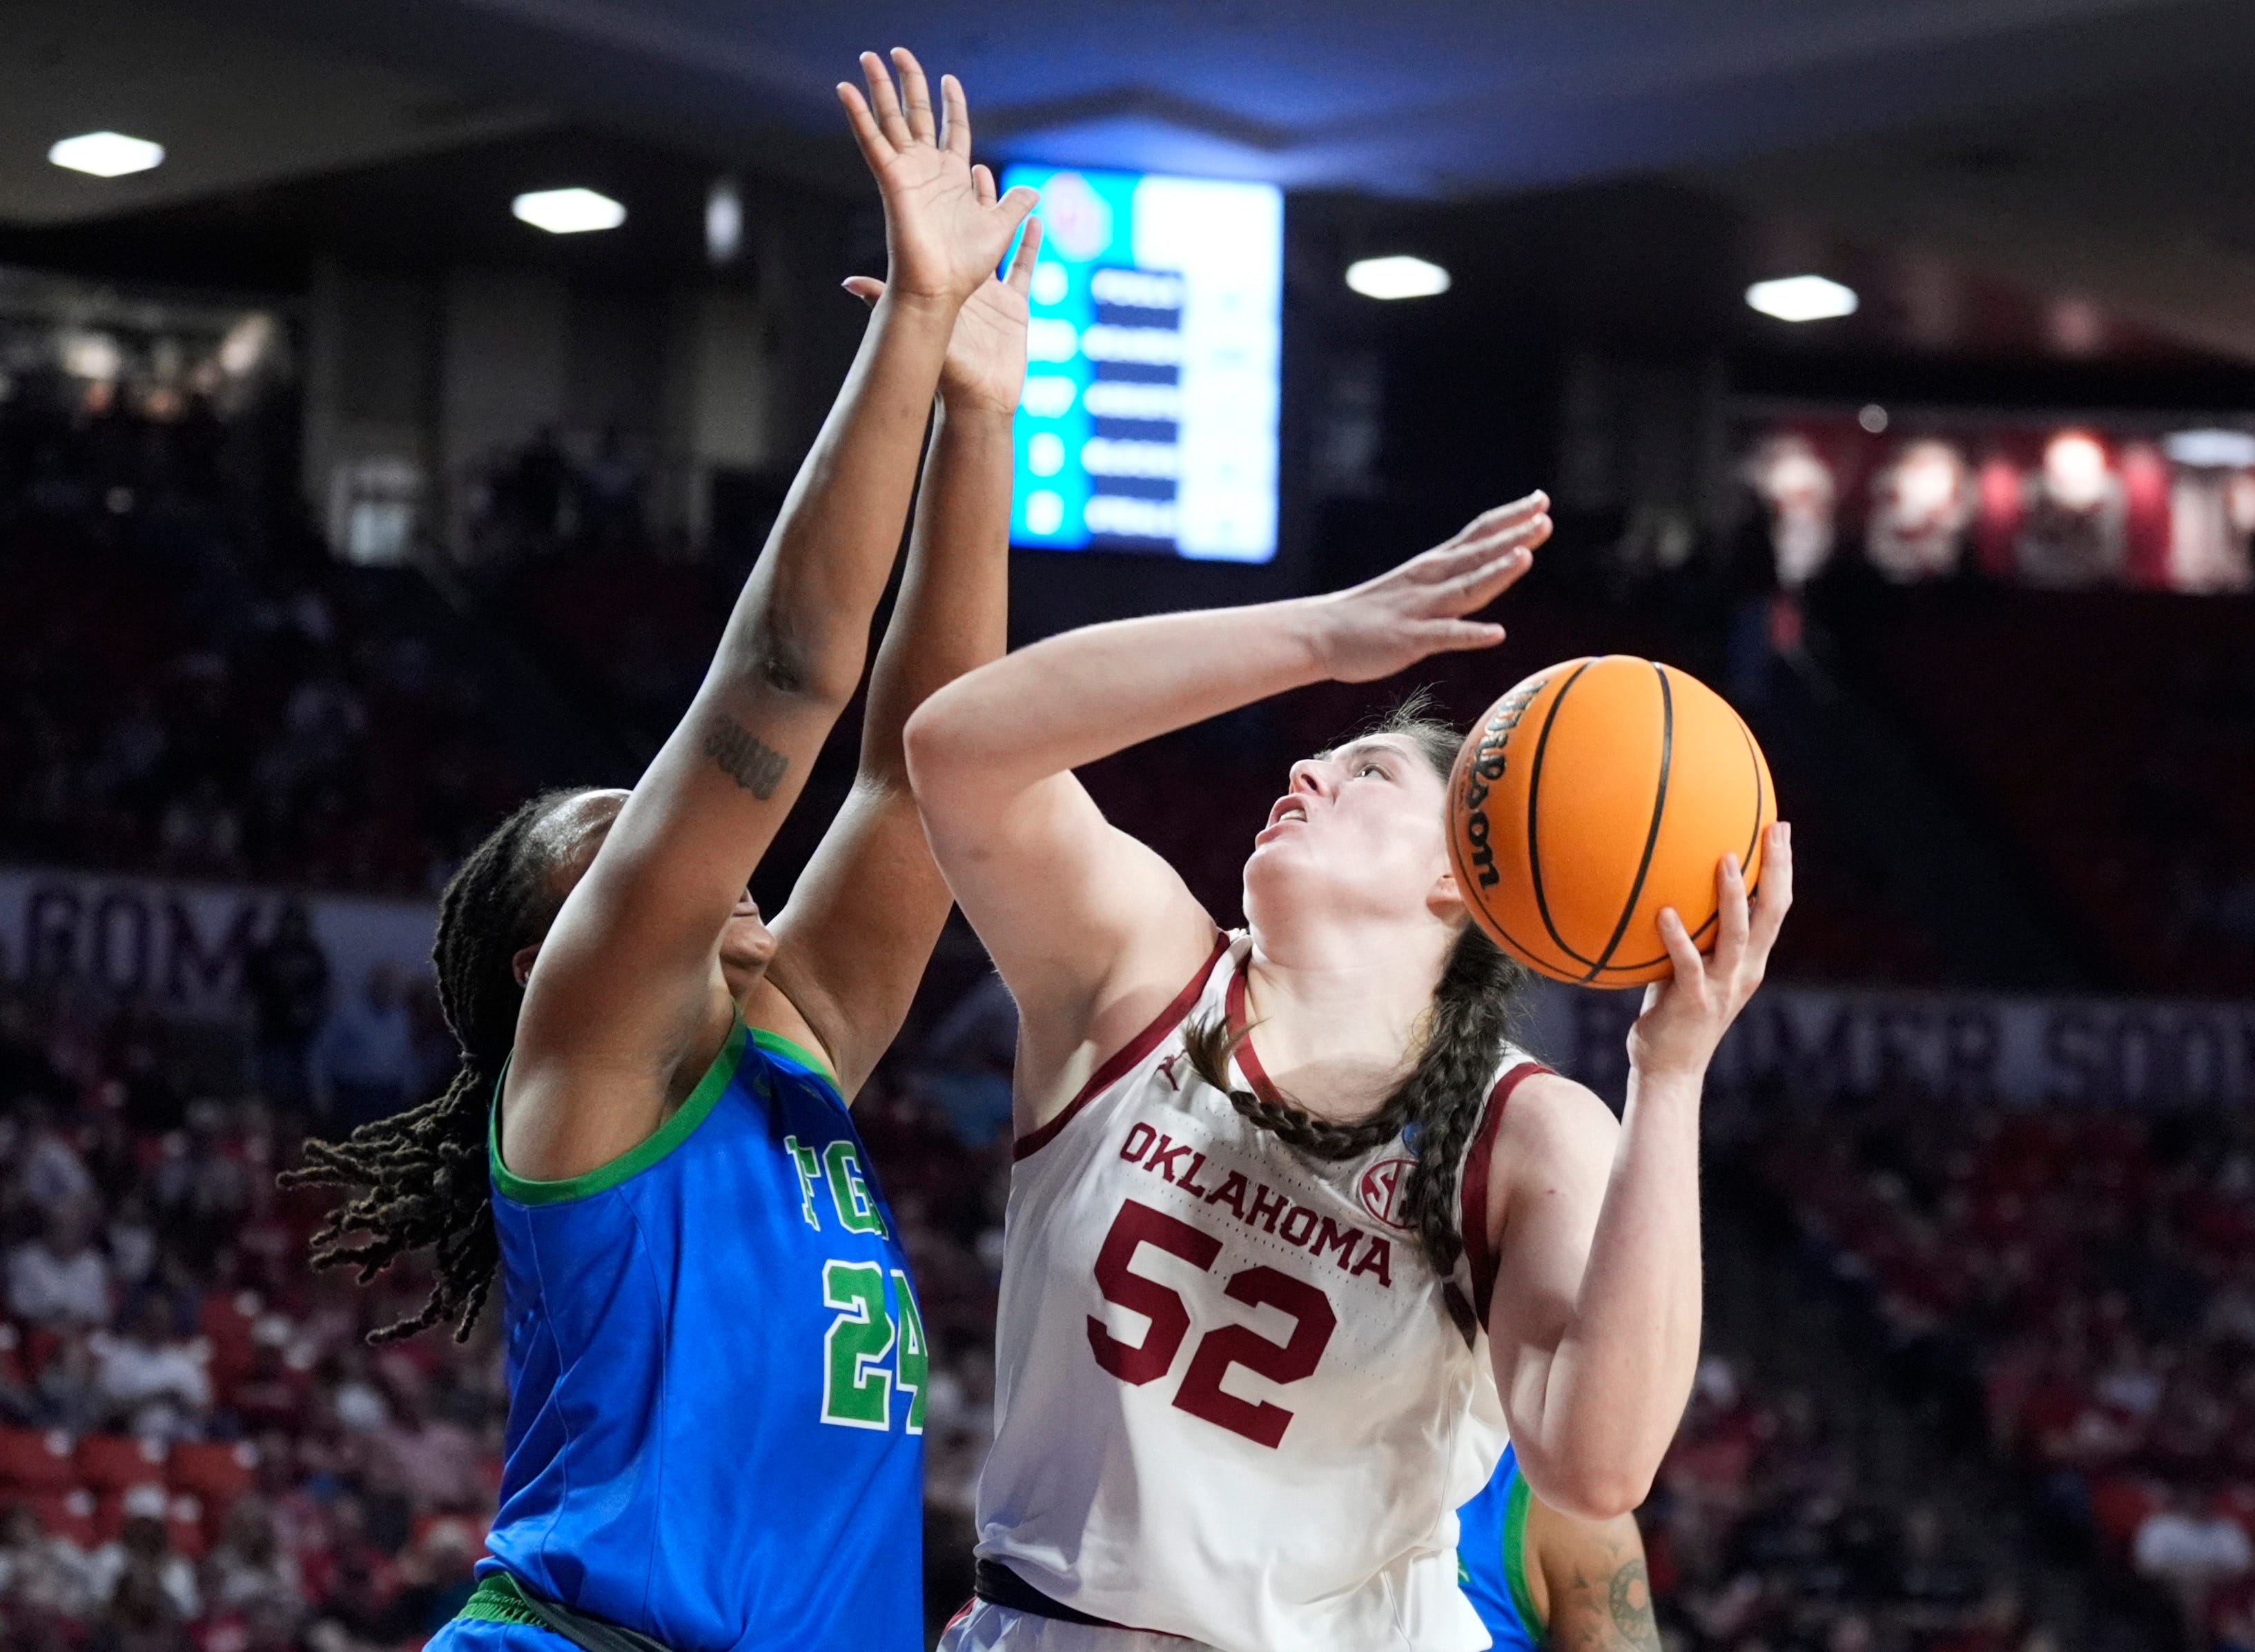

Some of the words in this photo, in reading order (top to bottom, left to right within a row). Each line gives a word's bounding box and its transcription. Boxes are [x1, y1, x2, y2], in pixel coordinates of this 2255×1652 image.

[1467, 679, 1548, 889] Wilson
[783, 1135, 889, 1240] FG
[1118, 1121, 1393, 1288] OKLAHOMA
[820, 1259, 928, 1435] 24
[1086, 1199, 1337, 1449] 52
